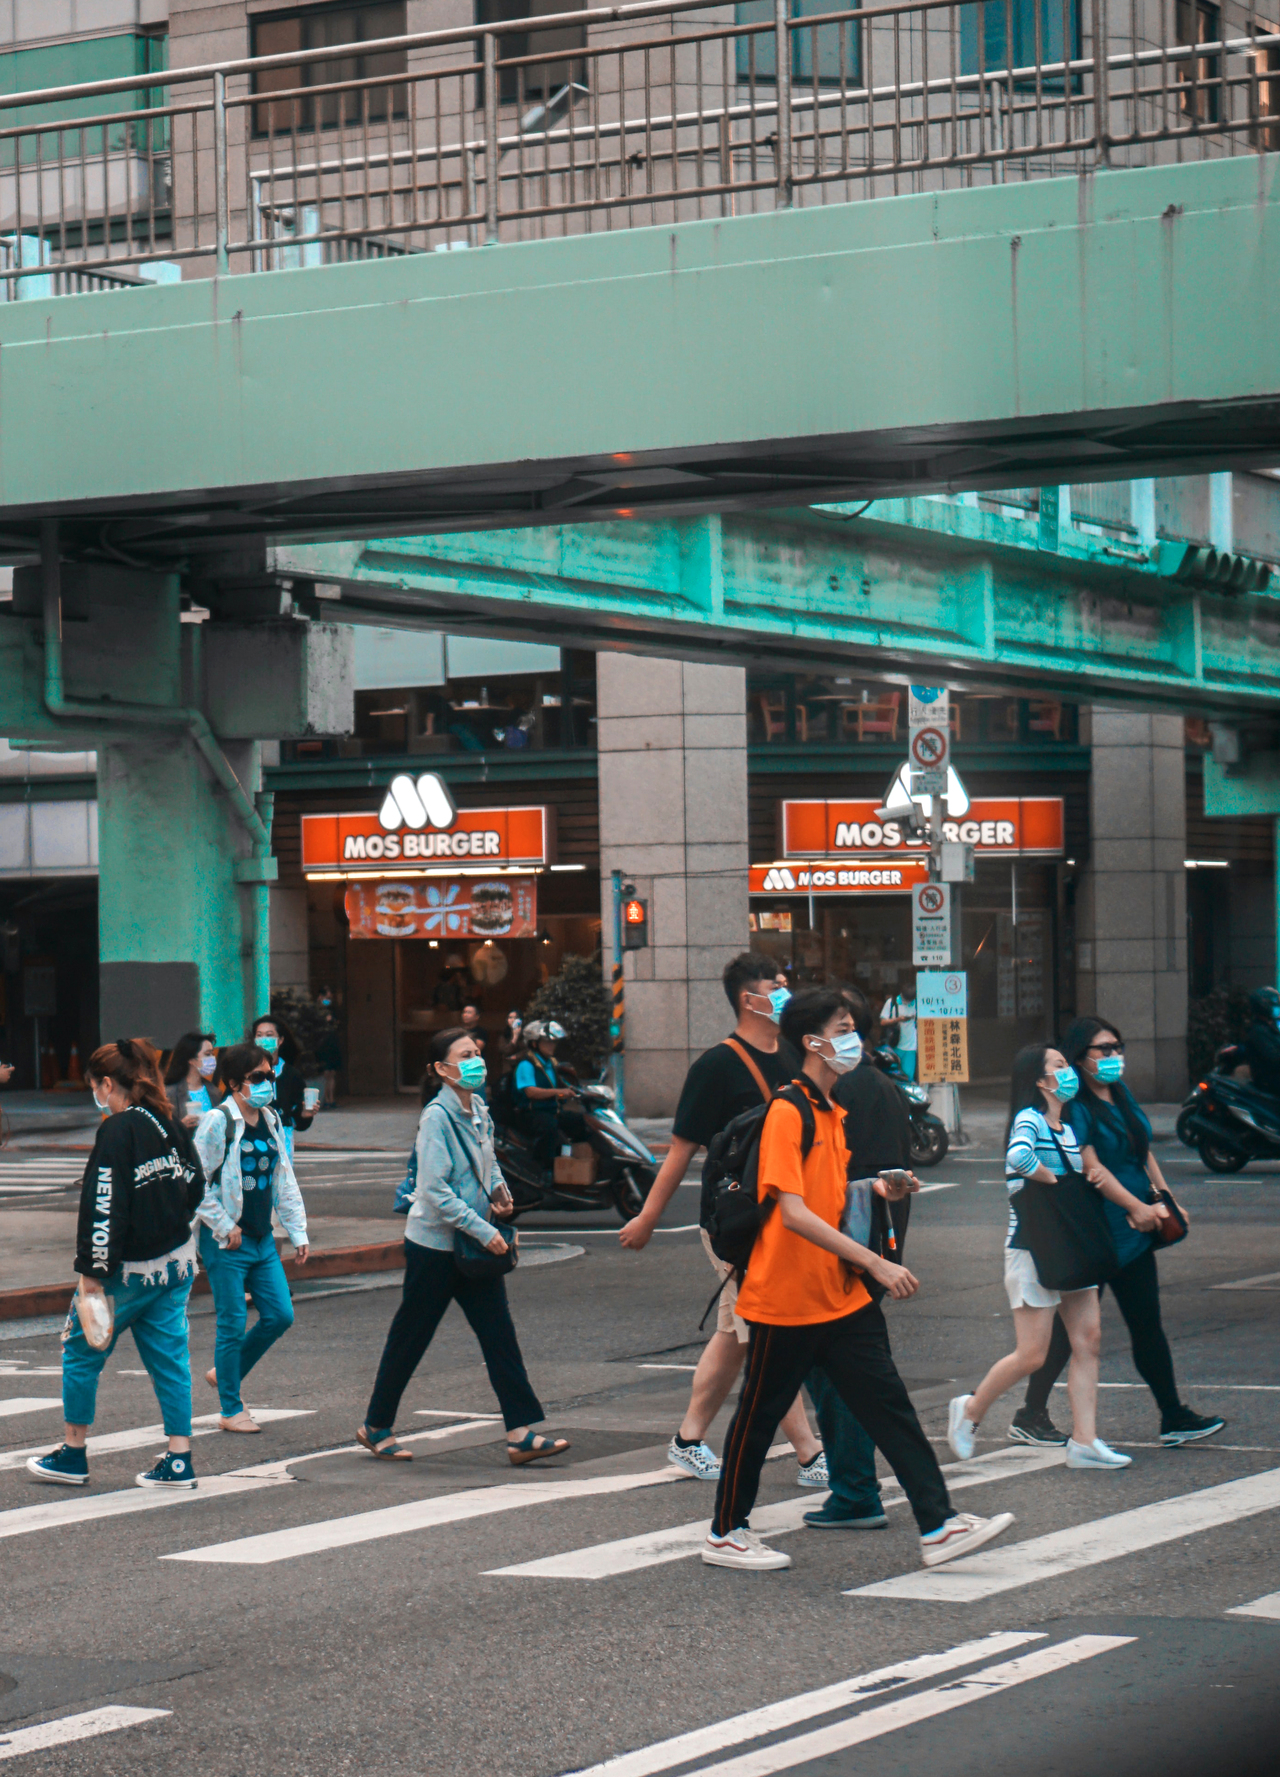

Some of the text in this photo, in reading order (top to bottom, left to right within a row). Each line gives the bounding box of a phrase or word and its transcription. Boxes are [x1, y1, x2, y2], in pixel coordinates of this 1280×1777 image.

[343, 830, 501, 860] MOS BURGER
[834, 819, 1015, 848] MOS RGER
[797, 869, 902, 887] MOS BURGER
[950, 1020, 962, 1071] 林森北路
[91, 1166, 113, 1272] NEW YORK
